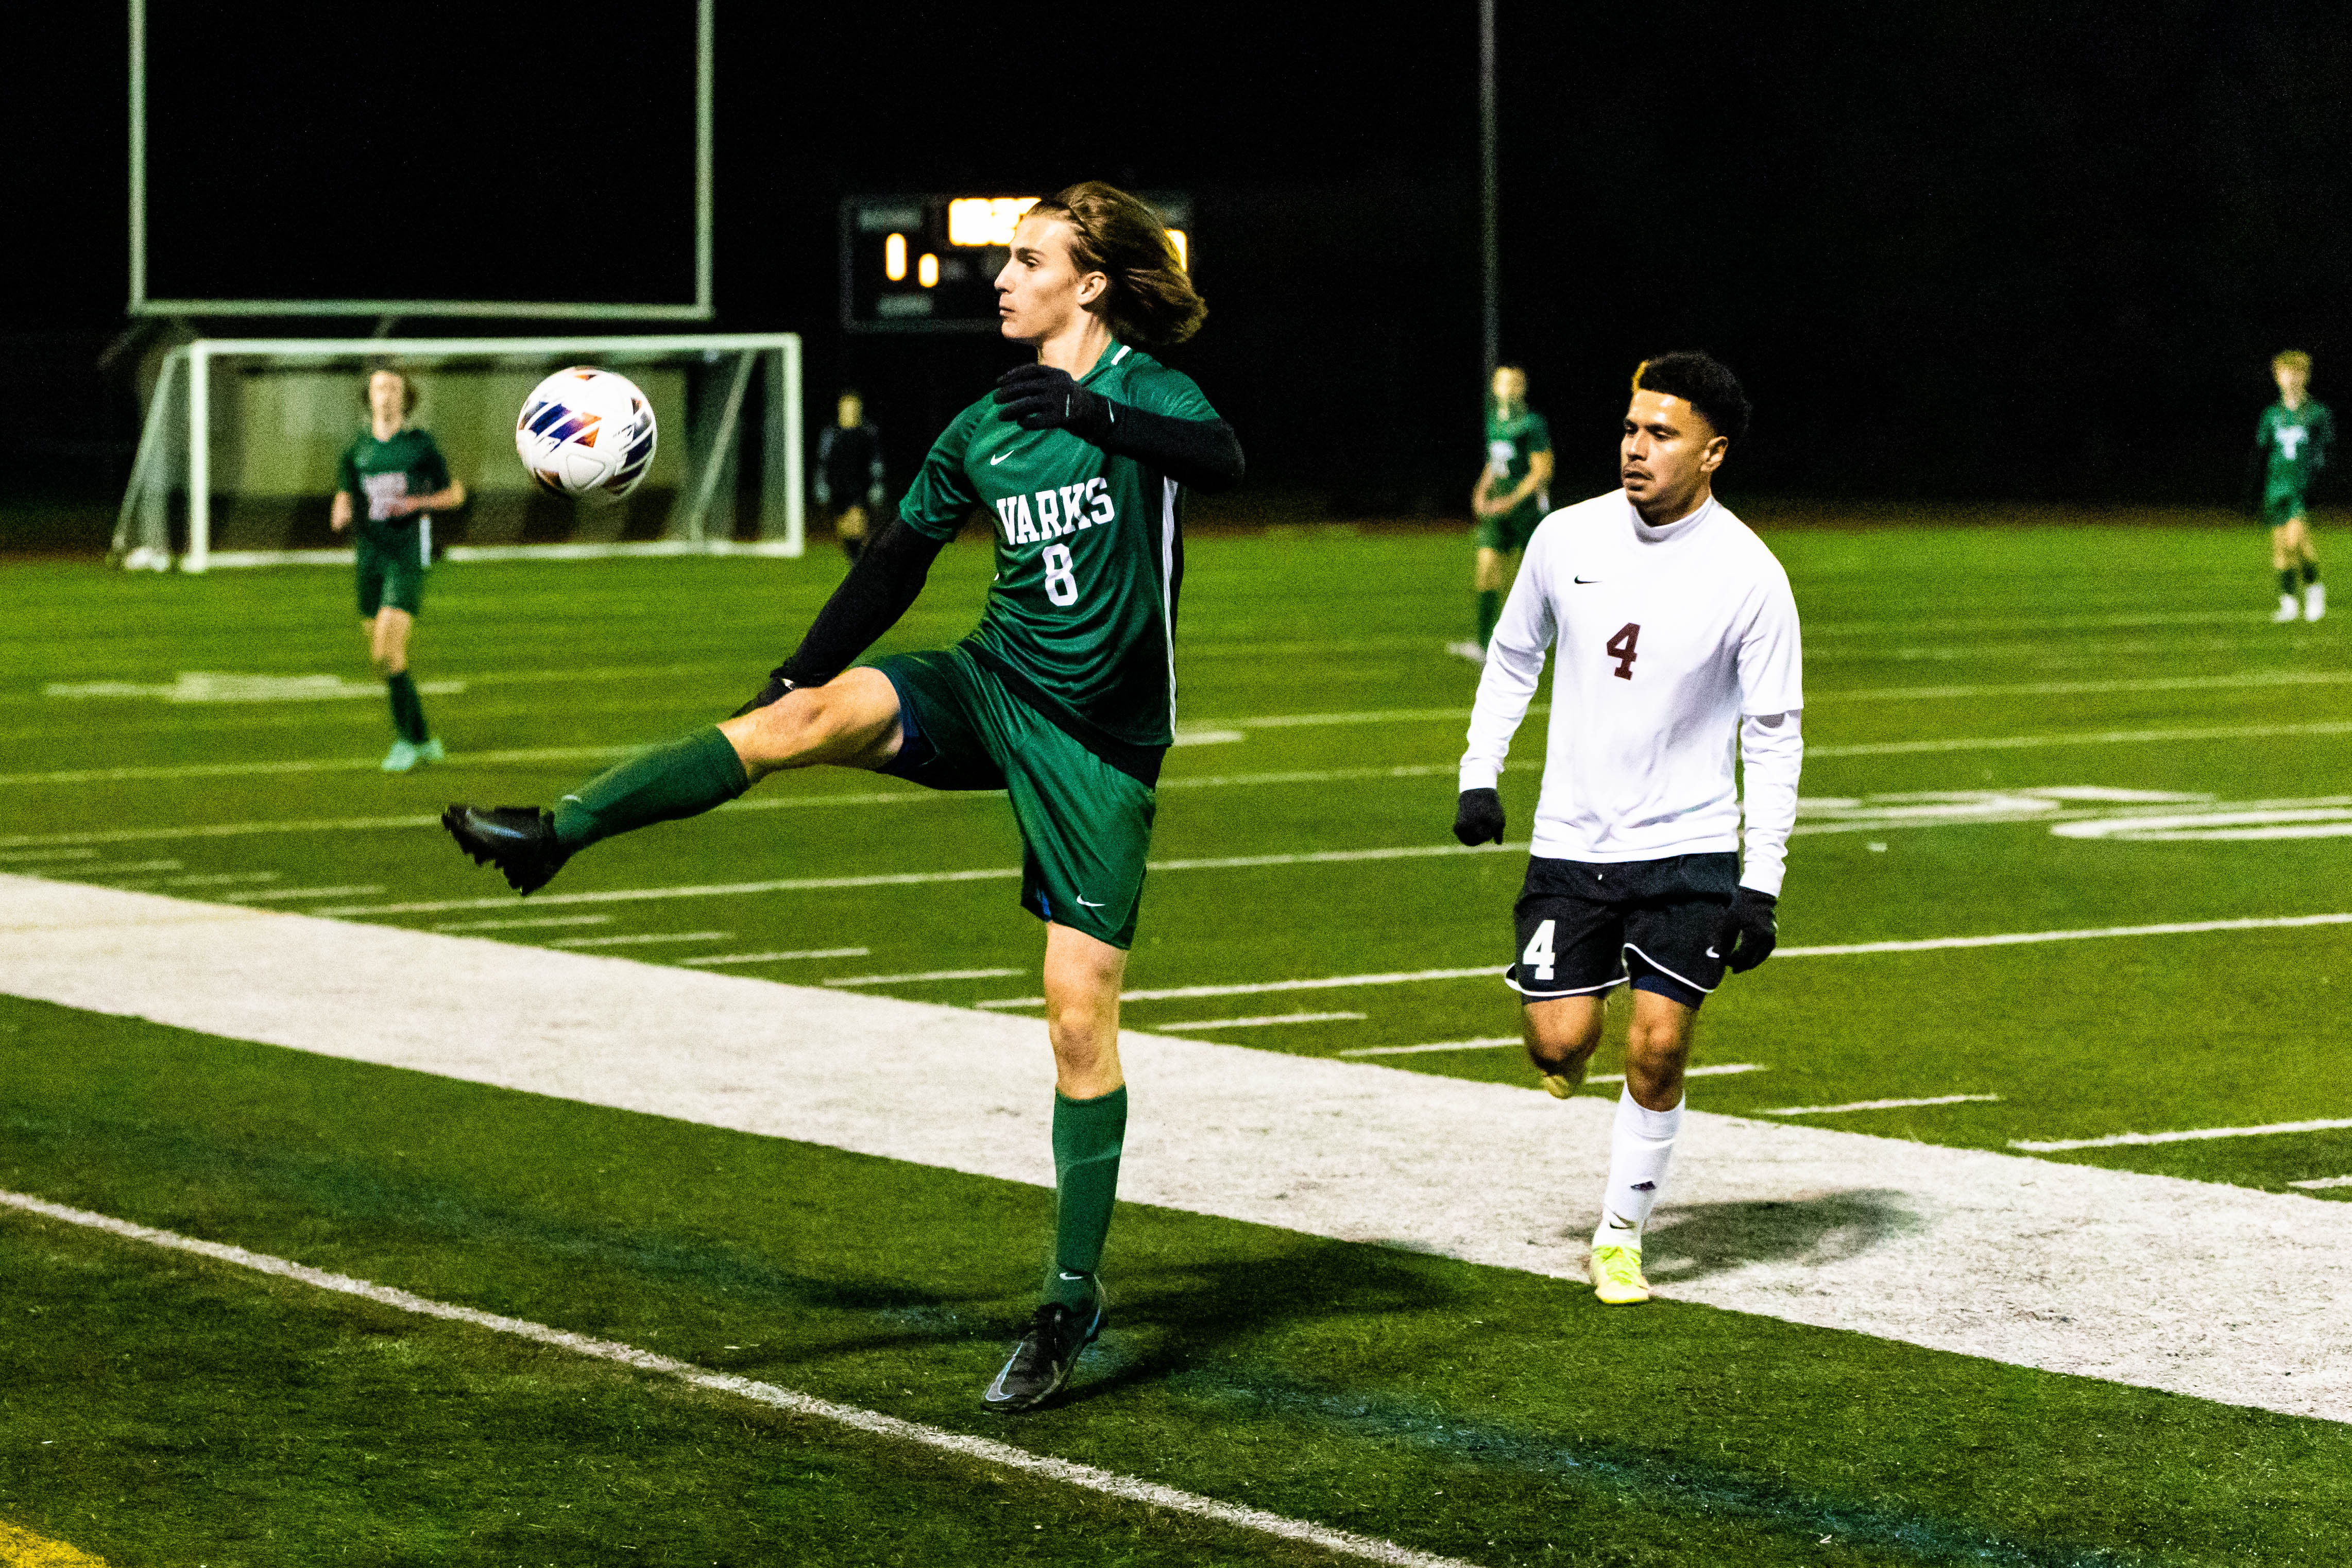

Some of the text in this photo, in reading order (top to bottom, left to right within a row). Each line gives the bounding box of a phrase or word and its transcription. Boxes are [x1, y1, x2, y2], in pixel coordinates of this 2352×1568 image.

[996, 477, 1115, 545] VARKS
[1042, 543, 1078, 606] 8
[1607, 623, 1641, 680] 4
[1523, 919, 1556, 980] 4
